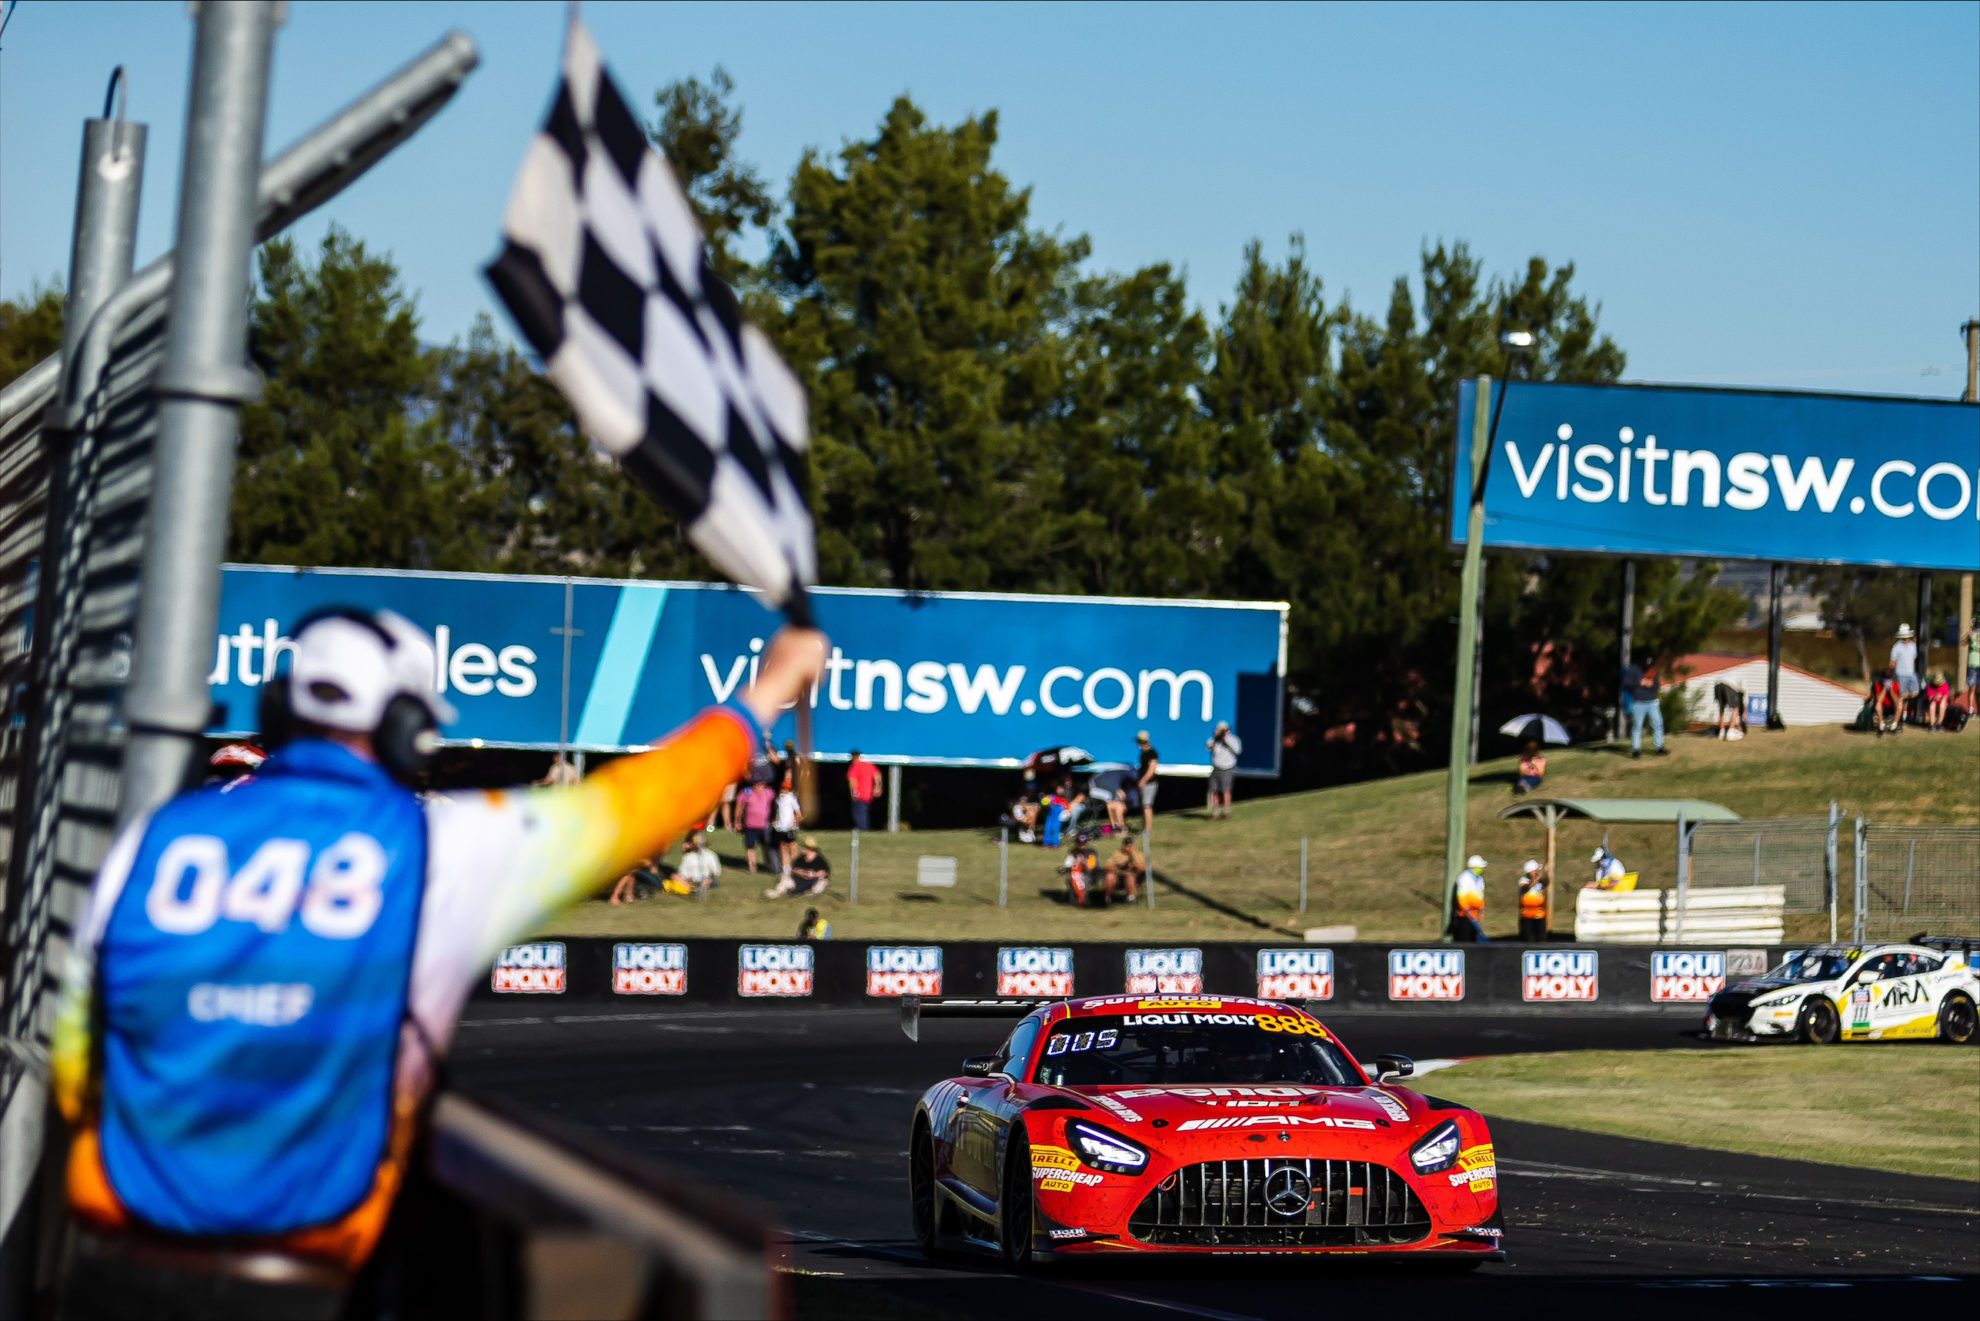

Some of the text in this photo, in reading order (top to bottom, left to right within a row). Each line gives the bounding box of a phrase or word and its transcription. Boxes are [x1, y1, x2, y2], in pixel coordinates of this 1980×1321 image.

[1505, 423, 1980, 521] visitnsw.co
[206, 618, 538, 697] uth les
[699, 637, 1214, 722] vitnsw.com
[145, 831, 388, 940] 048
[500, 947, 560, 968] LIQUI
[618, 947, 684, 968] LIQUI
[744, 949, 808, 969] LIQUI
[871, 950, 938, 970] LIQUI
[1003, 951, 1071, 972] LIQUI
[1130, 953, 1197, 974] LIQUI
[1262, 953, 1328, 973] LIQUI
[1393, 953, 1458, 974] LIQUI
[1527, 954, 1592, 975] LIQUI
[1656, 955, 1721, 976] LIQUI
[617, 969, 685, 992] MOLY
[743, 970, 810, 993] MOLY
[870, 971, 940, 994] MOLY
[1002, 973, 1071, 995] MOLY
[1130, 974, 1199, 994] MOLY
[1262, 975, 1330, 996] MOLY
[1393, 975, 1462, 997] MOLY
[1526, 976, 1594, 998] MOLY
[1656, 977, 1723, 1000] MOLY
[1123, 1014, 1257, 1026] LIQUI MOLY
[1254, 1013, 1328, 1038] 888
[1248, 1115, 1376, 1129] AMG
[1032, 1167, 1104, 1187] SUPERCHEAP
[1044, 1181, 1069, 1189] AUTO
[1473, 1181, 1491, 1189] AUTO
